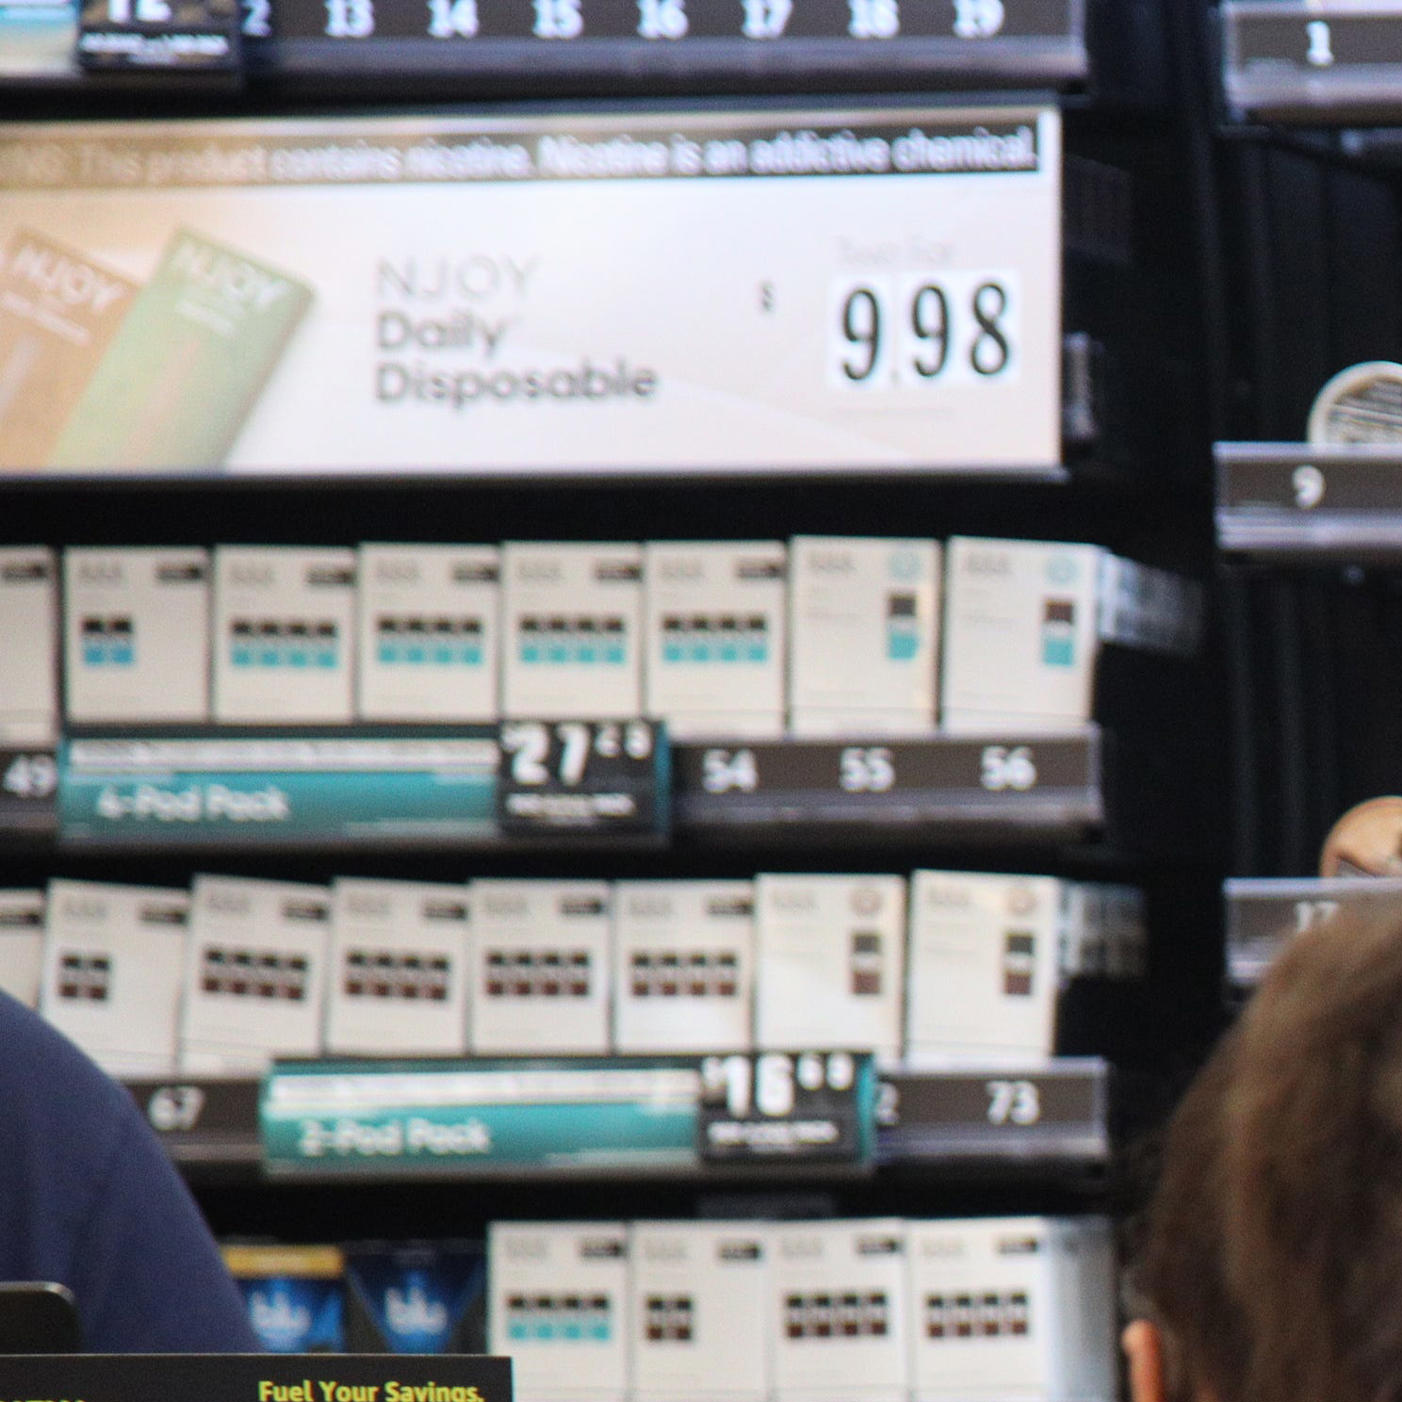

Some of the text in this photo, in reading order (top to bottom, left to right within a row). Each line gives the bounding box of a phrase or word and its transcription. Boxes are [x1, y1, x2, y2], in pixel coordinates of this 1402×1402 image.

[325, 0, 374, 38] 13
[428, 0, 478, 38] 14
[533, 0, 583, 38] 15
[637, 0, 688, 38] 16
[742, 0, 792, 38] 17
[953, 0, 1003, 38] 19
[1306, 20, 1333, 65] 1
[377, 255, 538, 299] NJOY
[376, 311, 502, 358] Daily
[376, 358, 656, 408] Disposable
[1293, 465, 1326, 509] 9
[702, 745, 1036, 793] 54 55 56
[986, 1079, 1039, 1127] 73
